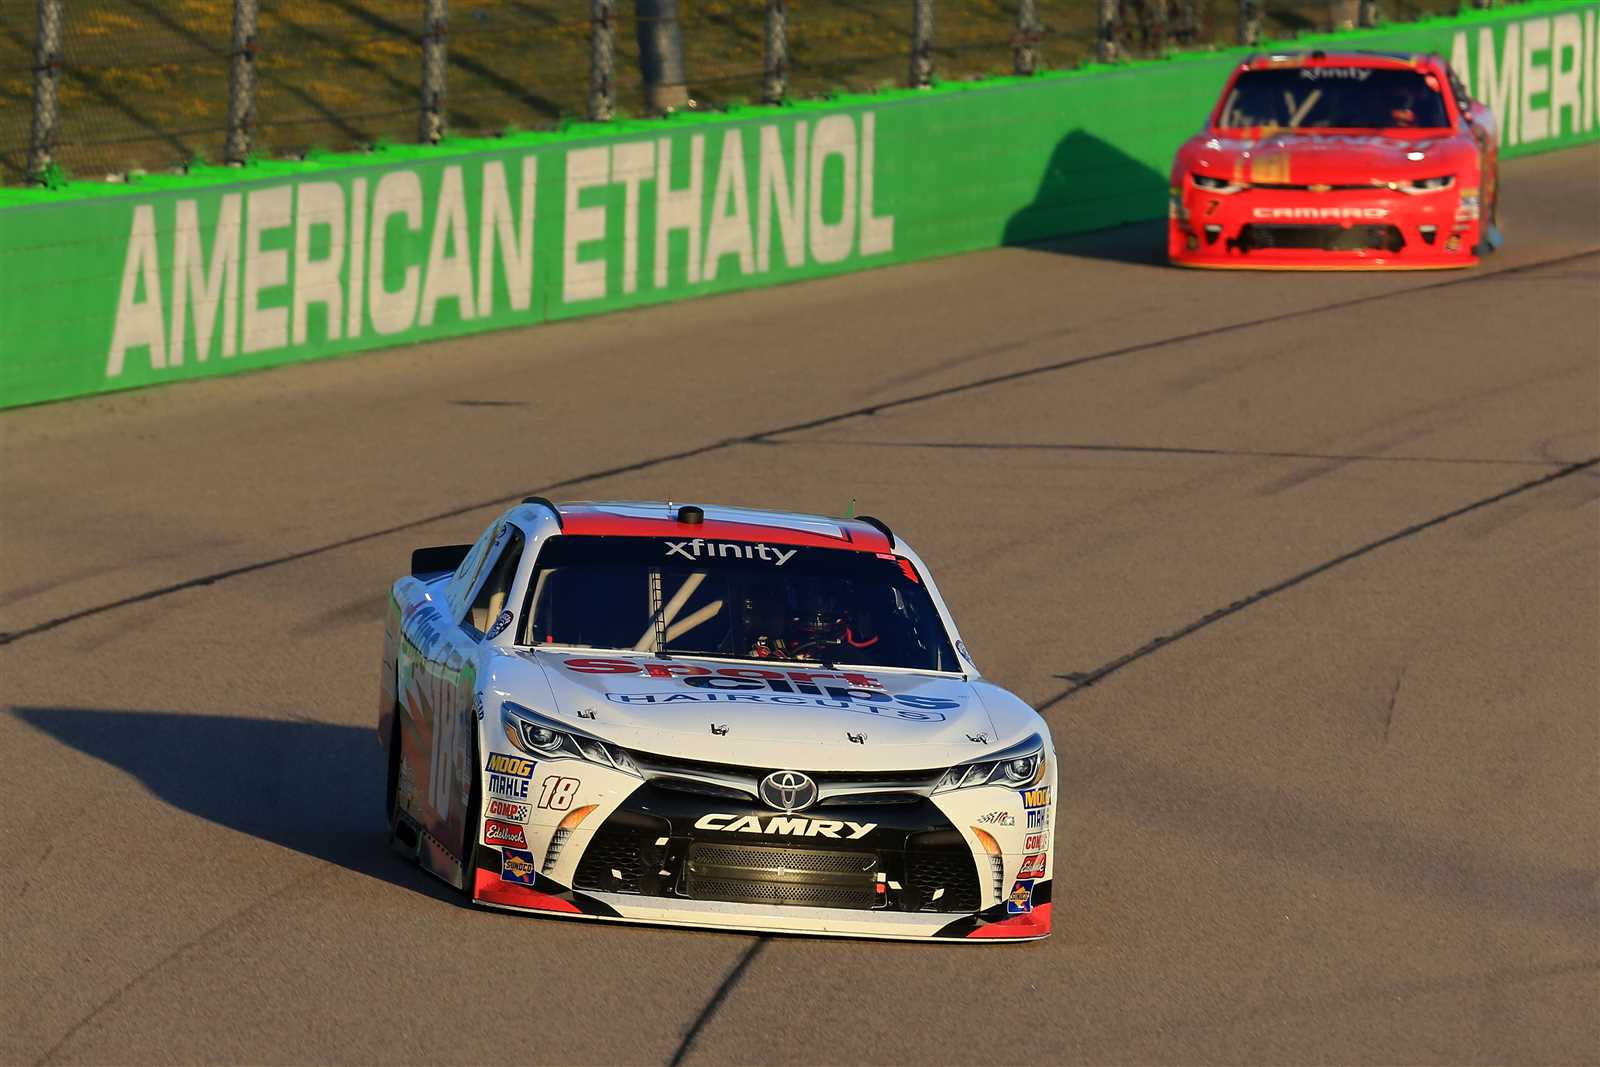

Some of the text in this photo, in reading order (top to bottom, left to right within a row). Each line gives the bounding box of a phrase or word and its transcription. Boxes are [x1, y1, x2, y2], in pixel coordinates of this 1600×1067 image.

[1451, 10, 1600, 146] MERI
[1253, 206, 1391, 218] CAMARO
[105, 111, 894, 377] AMERICAN ETHANOL
[664, 538, 797, 566] xfinity
[620, 693, 930, 720] HAIRCUTS
[488, 754, 534, 777] MOOG
[489, 774, 529, 797] MAHLE
[538, 775, 580, 811] 18
[490, 801, 518, 817] COMP
[486, 825, 525, 843] Edelbrock
[694, 813, 877, 839] CAMRY
[505, 860, 533, 873] SUNOCO
